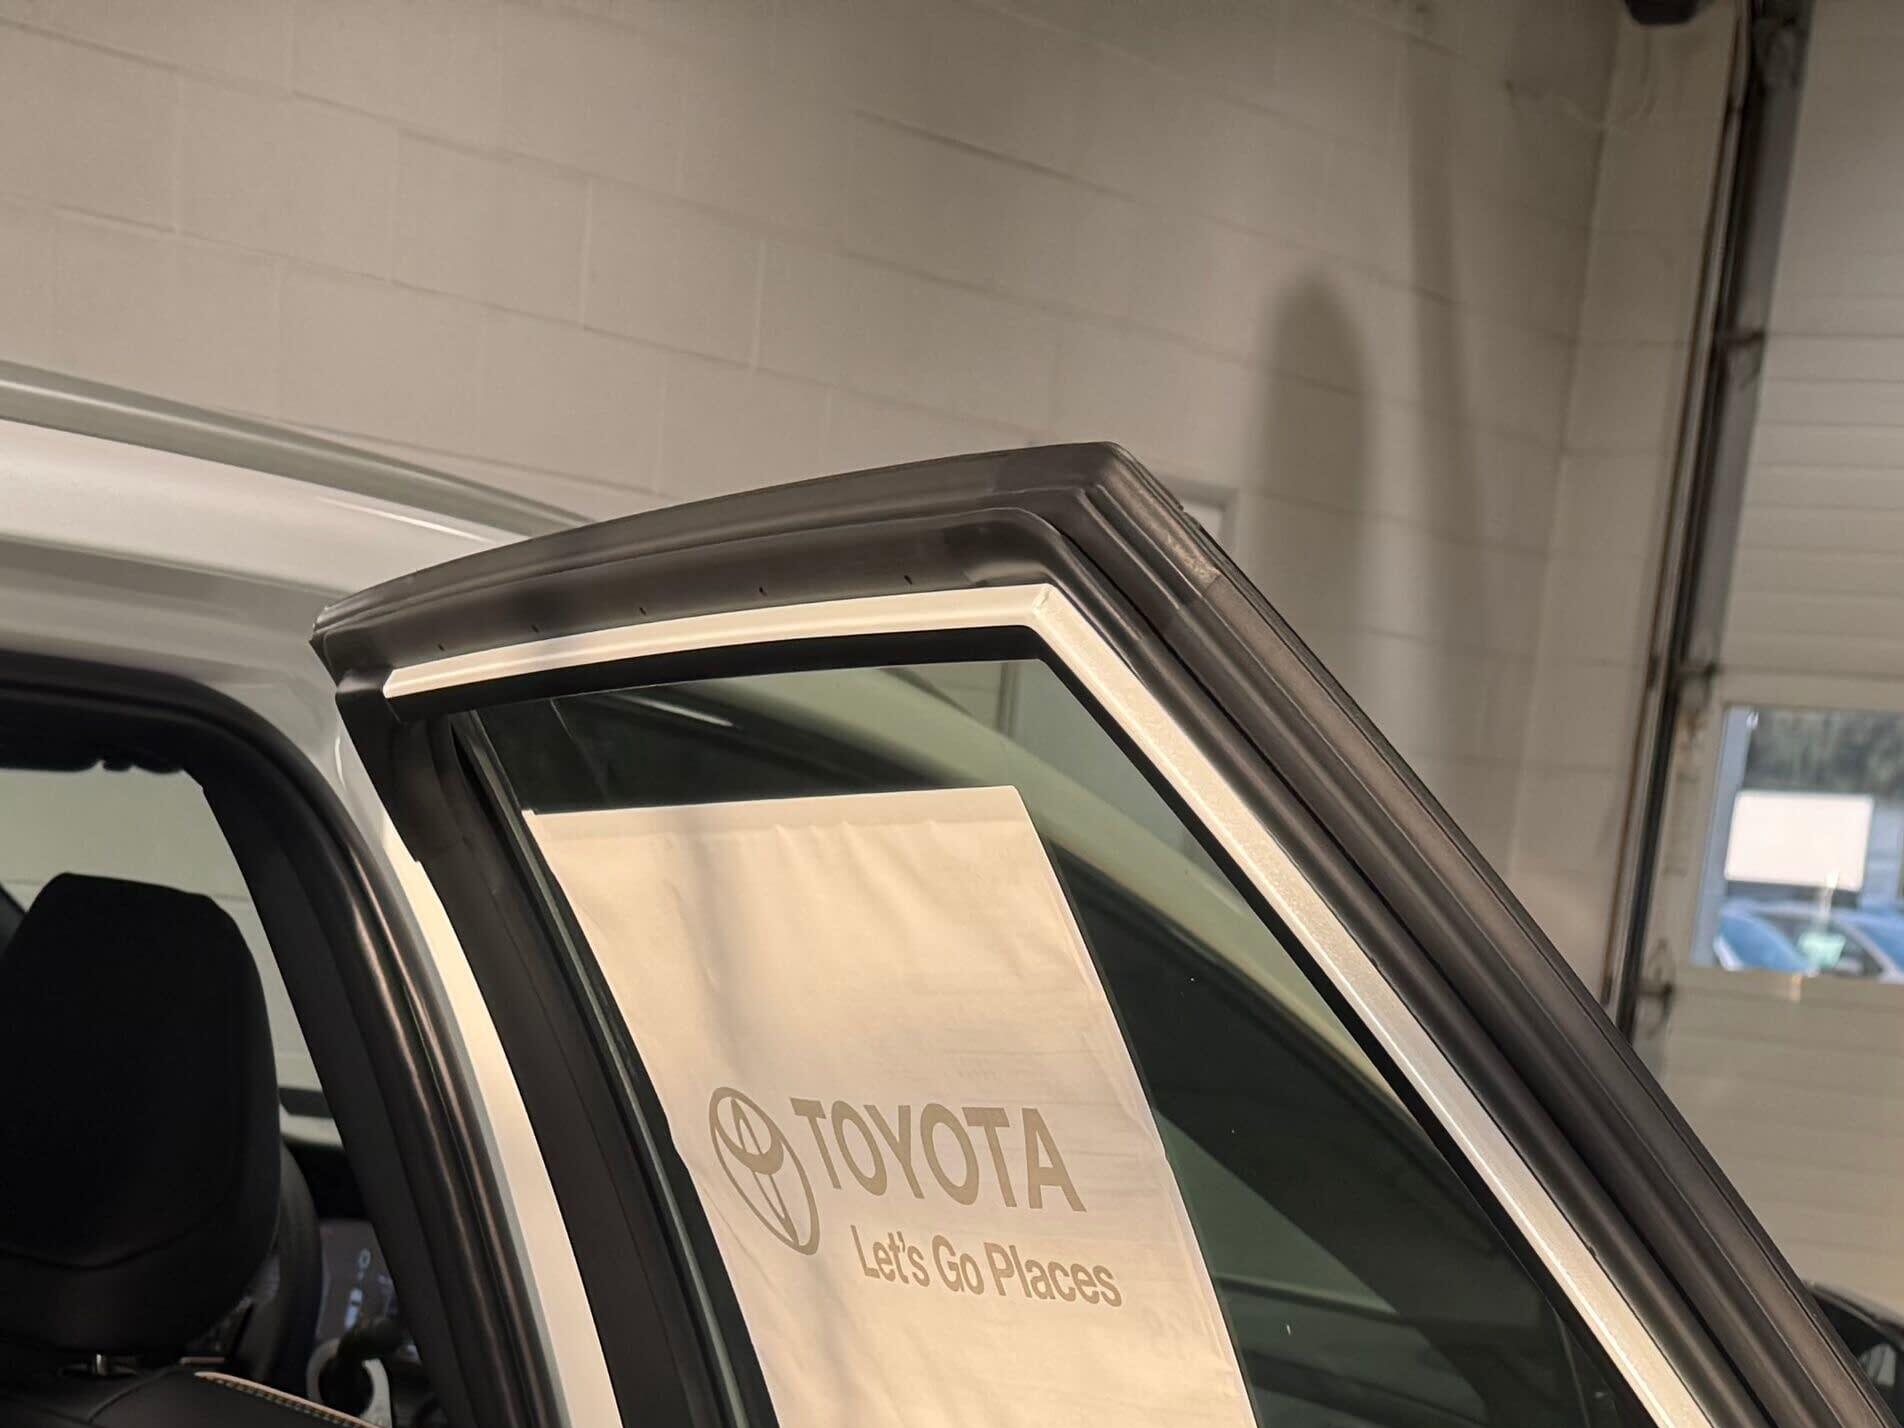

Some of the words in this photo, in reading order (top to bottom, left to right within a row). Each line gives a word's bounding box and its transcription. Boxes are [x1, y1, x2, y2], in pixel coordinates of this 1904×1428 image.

[790, 1097, 1087, 1212] TOYOTA
[850, 1224, 931, 1287] Let's
[932, 1234, 985, 1295] Go
[983, 1241, 1122, 1307] Places
